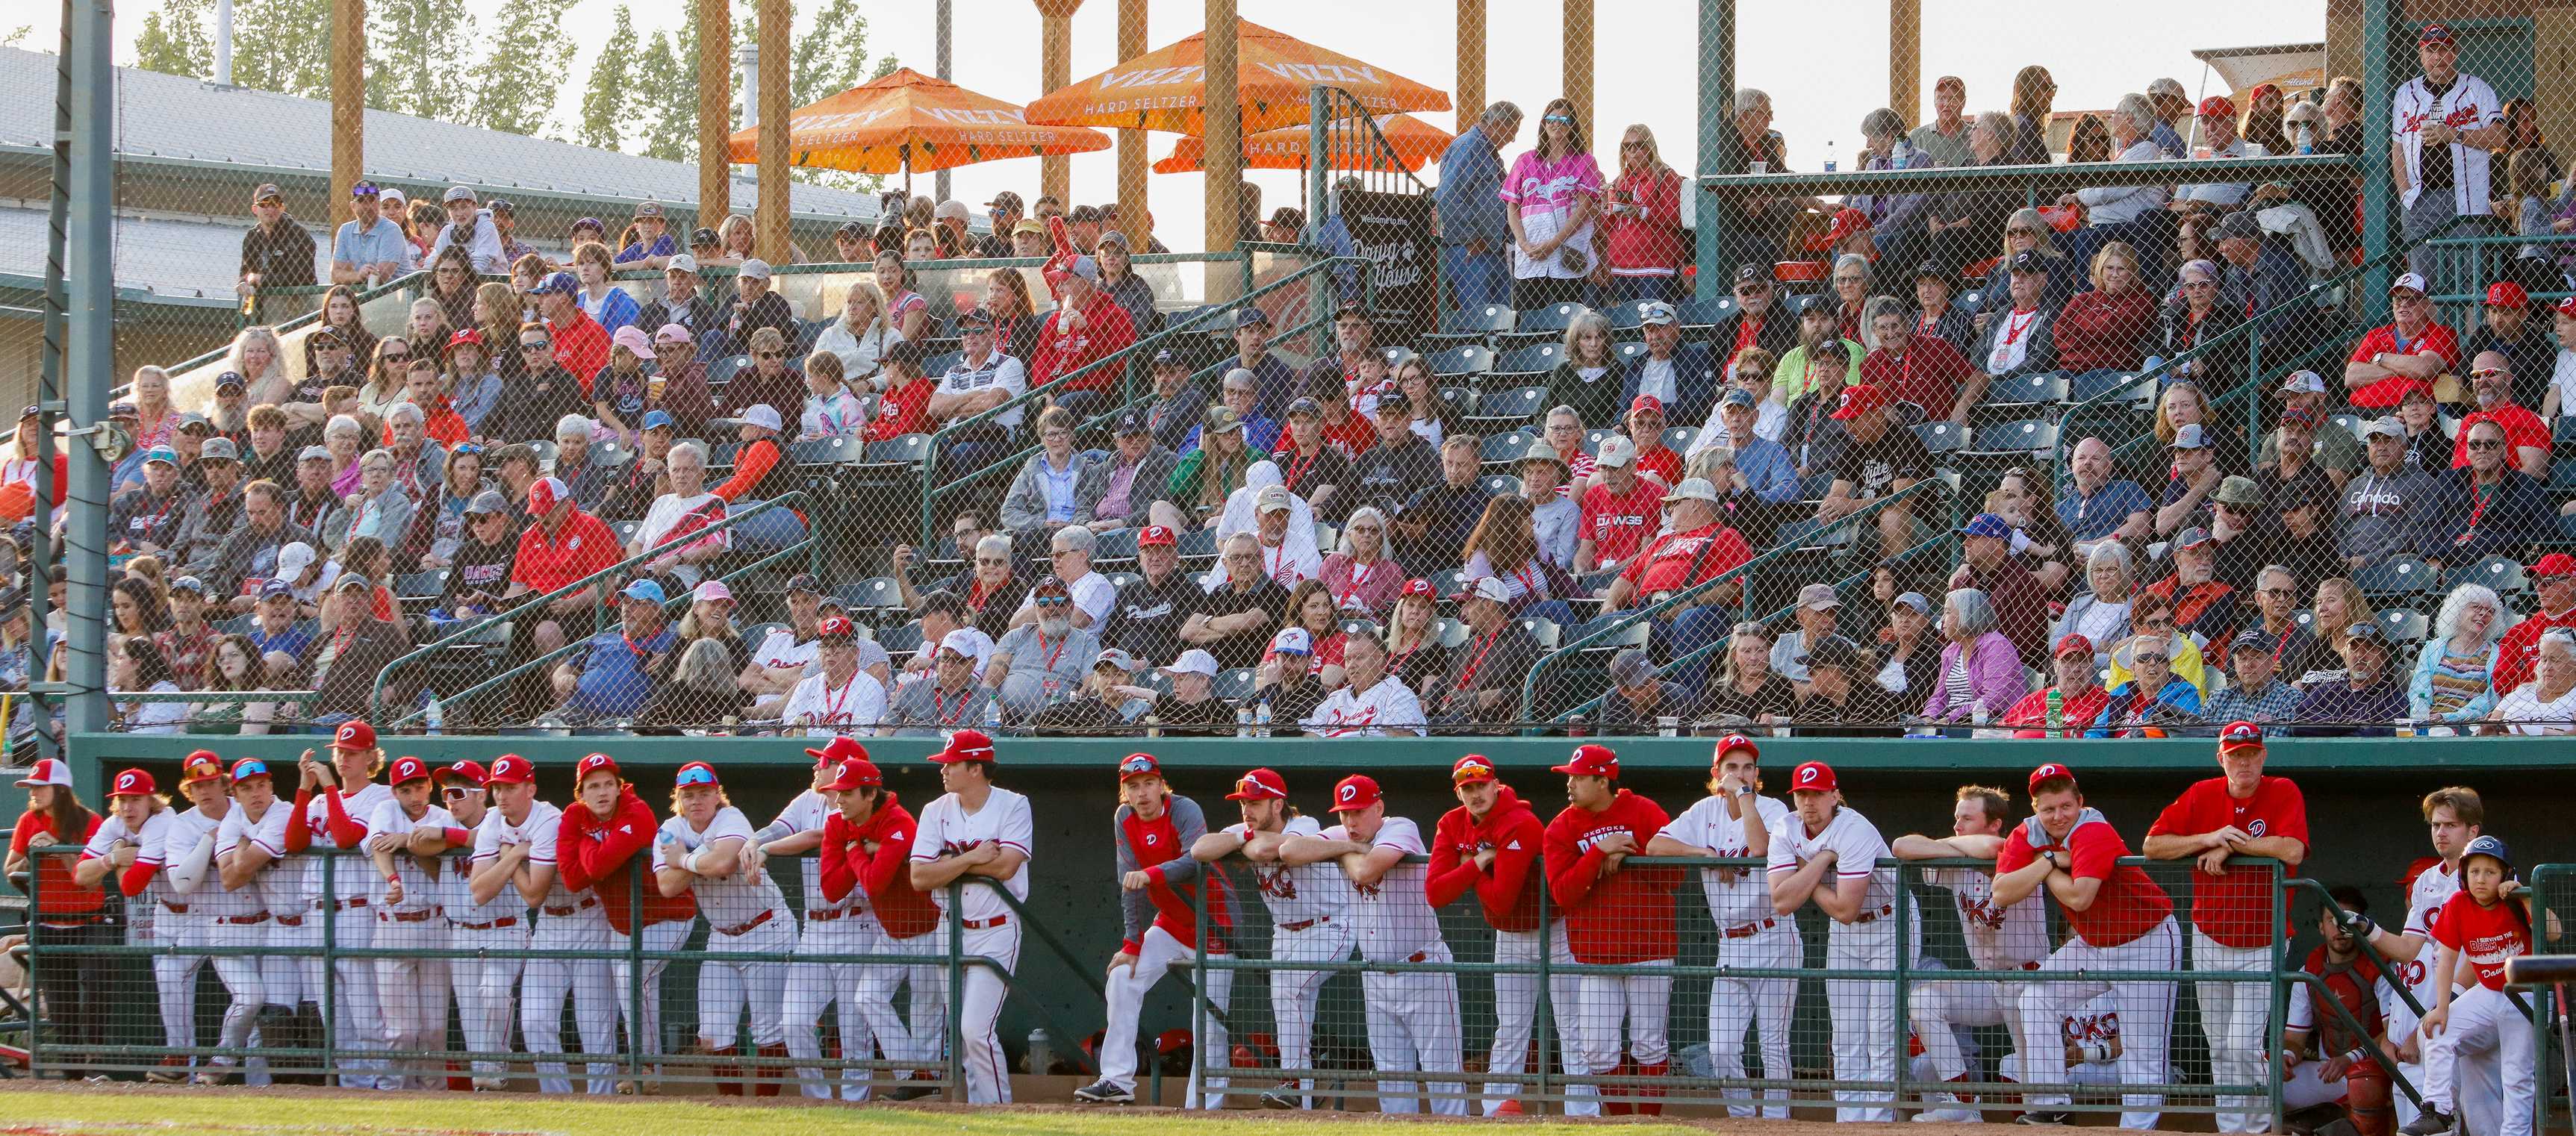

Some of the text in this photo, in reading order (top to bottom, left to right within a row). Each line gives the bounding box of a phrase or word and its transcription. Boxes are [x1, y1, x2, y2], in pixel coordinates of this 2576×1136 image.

[1256, 62, 1381, 84] VIZZY
[1086, 96, 1197, 115] HARD SELTZER
[798, 131, 859, 147] SELTZER
[959, 131, 1056, 142] HARD SELTZER
[1249, 142, 1301, 153] HARD
[1361, 213, 1389, 224] Welcome
[1351, 239, 1399, 269] Dawg
[1375, 262, 1421, 294] House
[2351, 491, 2401, 505] Canada
[340, 727, 356, 741] D
[589, 754, 606, 767] D
[399, 761, 416, 777] D
[496, 761, 511, 775] D
[836, 764, 847, 780] D
[1801, 767, 1817, 783] D
[119, 774, 136, 789] D
[1341, 784, 1357, 802] D
[1583, 825, 1625, 837] OKOTOKS
[1146, 834, 1157, 845] D
[2504, 930, 2514, 939] THE
[2470, 940, 2498, 951] BERM
